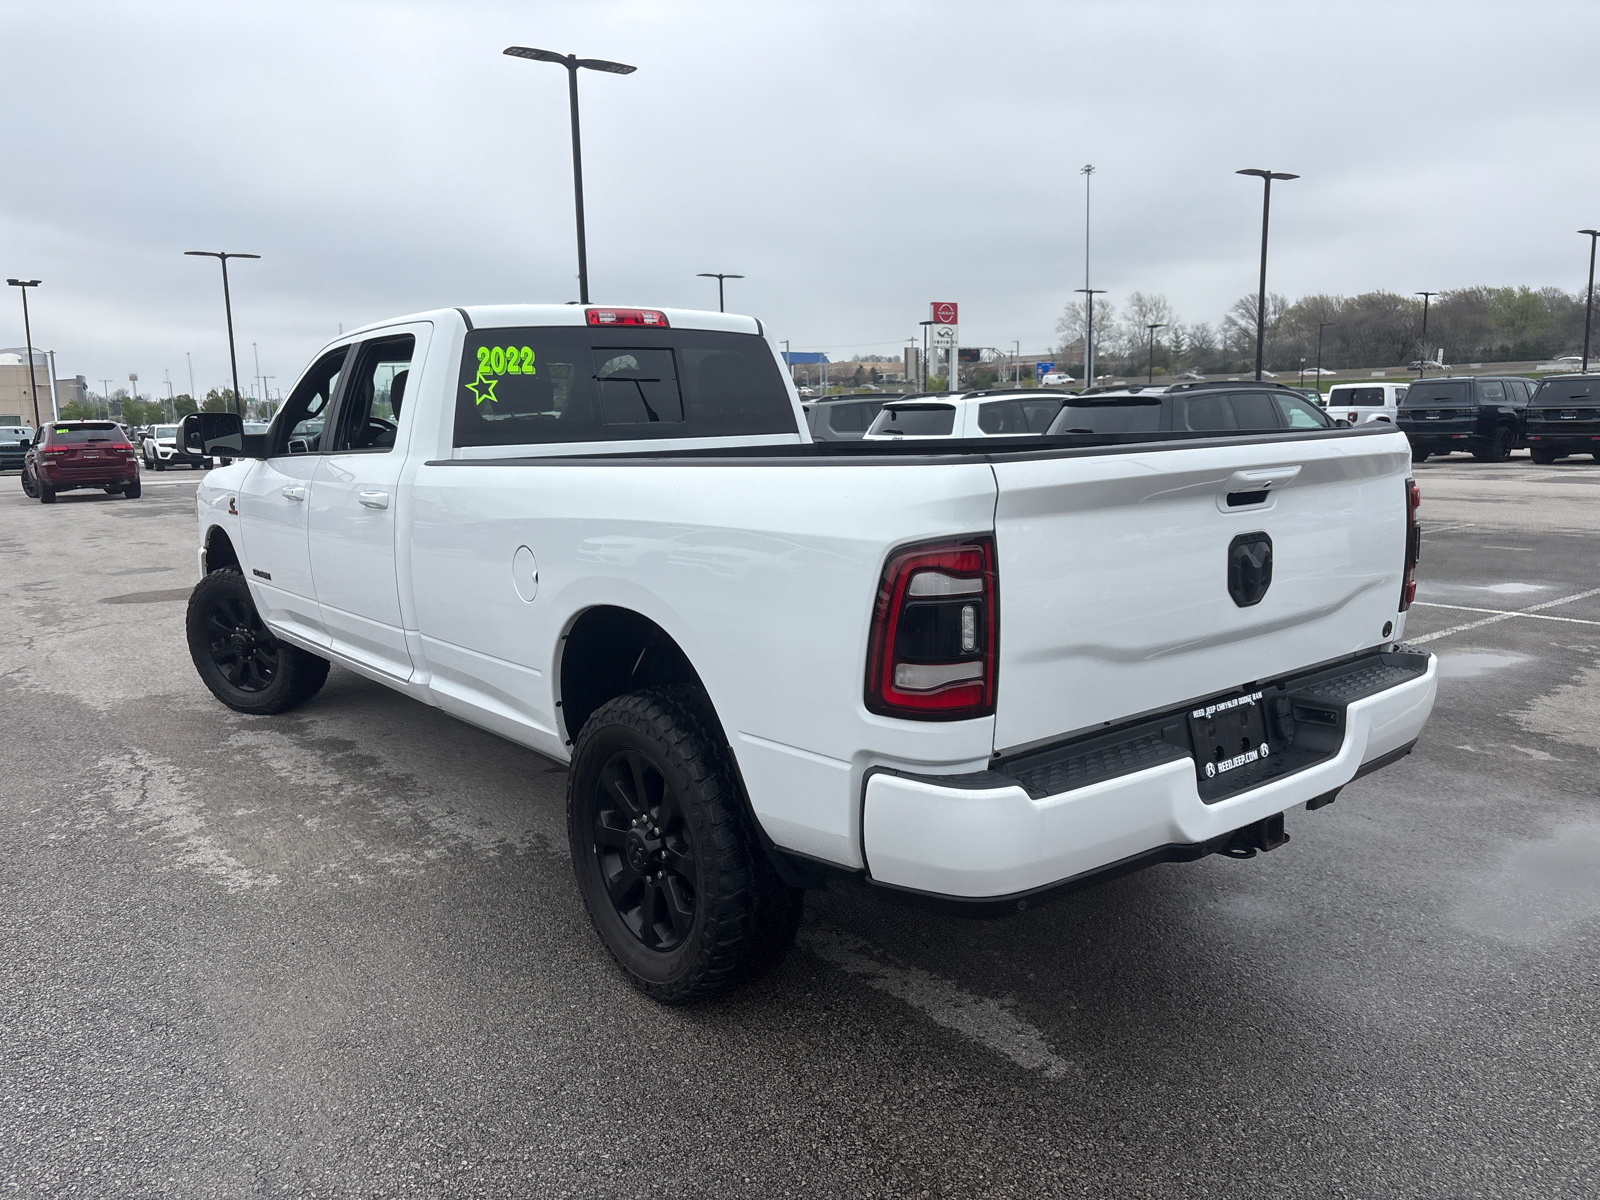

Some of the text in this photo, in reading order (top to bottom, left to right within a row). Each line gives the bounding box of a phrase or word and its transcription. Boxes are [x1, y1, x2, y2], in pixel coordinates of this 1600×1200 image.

[477, 346, 536, 375] 2022
[1193, 691, 1262, 718] REED JEEP CHRYSLER DODGE RAM
[1218, 750, 1258, 773] REEDJEEP.COM
